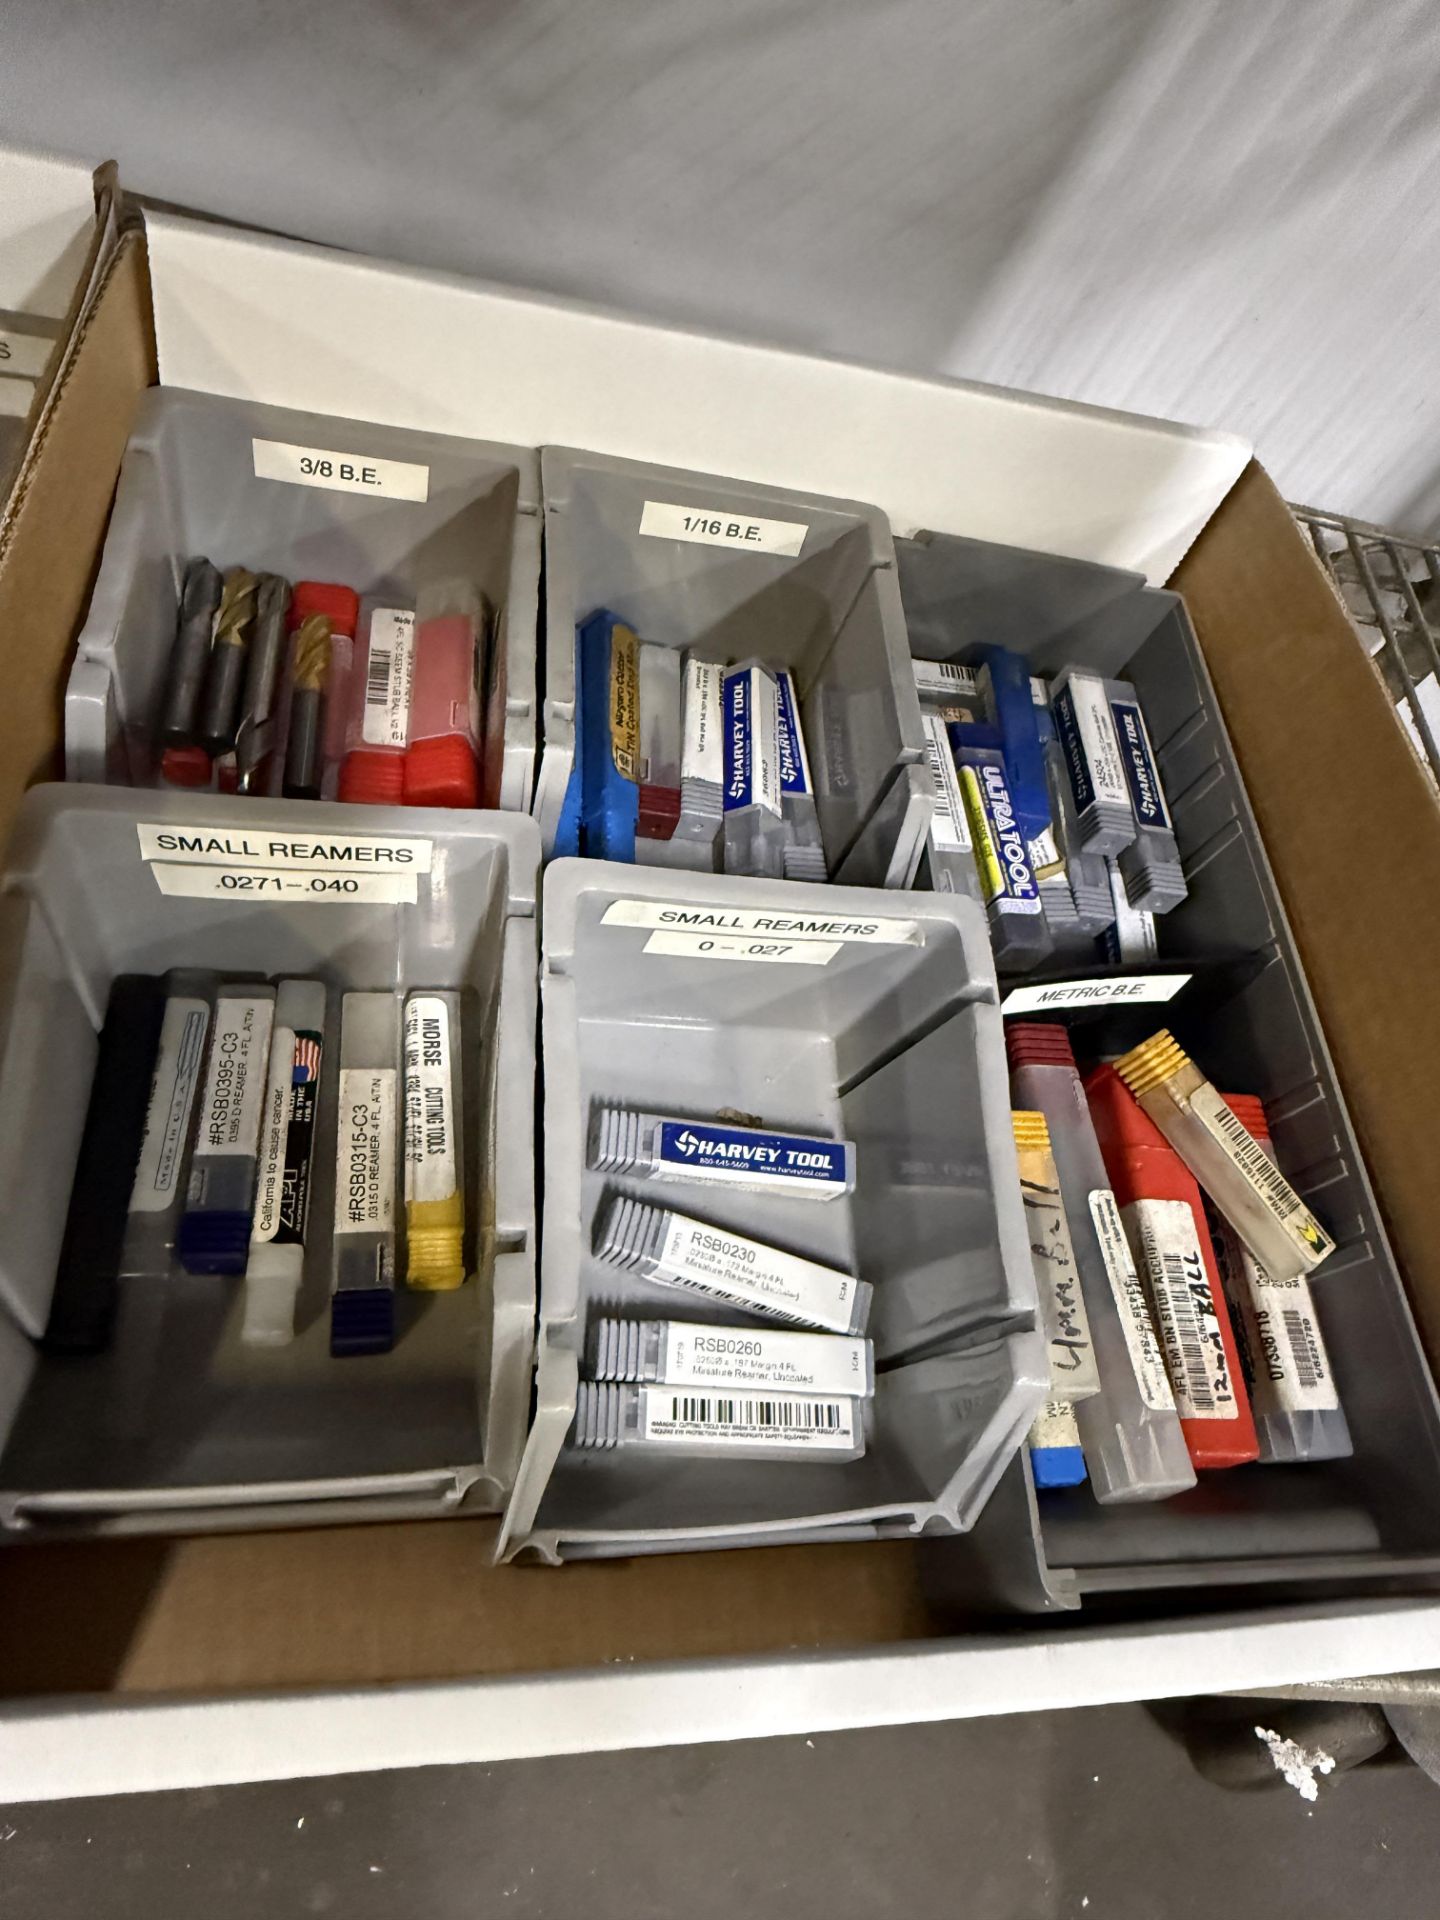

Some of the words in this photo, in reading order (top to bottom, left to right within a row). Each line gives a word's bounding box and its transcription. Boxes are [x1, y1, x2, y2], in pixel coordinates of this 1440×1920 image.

[300, 457, 333, 478] 3/8
[340, 464, 382, 486] B.E.
[683, 516, 721, 535] 1/16
[726, 523, 762, 542] B.E.
[733, 681, 744, 717] TOOL
[1060, 697, 1070, 729] TOOL
[778, 716, 794, 773] HARVEY
[1123, 714, 1138, 744] TOOL
[733, 721, 745, 781] HARVEY
[1068, 730, 1083, 787] HARVEY
[1132, 749, 1153, 798] HARVEY
[983, 766, 1016, 832] ULTRA
[1000, 831, 1032, 897] TOOL
[157, 834, 259, 857] SMALL
[269, 842, 414, 863] REAMERS
[658, 911, 744, 928] SMALL
[753, 918, 879, 936] REAMERS
[1036, 985, 1110, 1003] METRIC
[1111, 983, 1146, 996] B.E.
[422, 1018, 442, 1067] MORSE
[208, 1032, 239, 1147] #RSB0395-C3
[272, 1084, 284, 1127] cancer.
[425, 1086, 445, 1125] CUTTING
[372, 1123, 380, 1131] 4
[427, 1124, 446, 1156] TOOLS
[269, 1128, 281, 1161] cause
[698, 1140, 781, 1163] HARVEY
[785, 1150, 833, 1170] TOOL
[267, 1162, 276, 1175] to
[348, 1103, 368, 1223] #RSB0315-C3
[259, 1175, 276, 1232] California
[370, 1182, 379, 1193] D
[690, 1231, 756, 1264] RSB0230
[1184, 1250, 1217, 1317] BALL
[1158, 1285, 1173, 1324] STUB
[694, 1336, 763, 1356] RSB0260
[1171, 1348, 1184, 1369] EM
